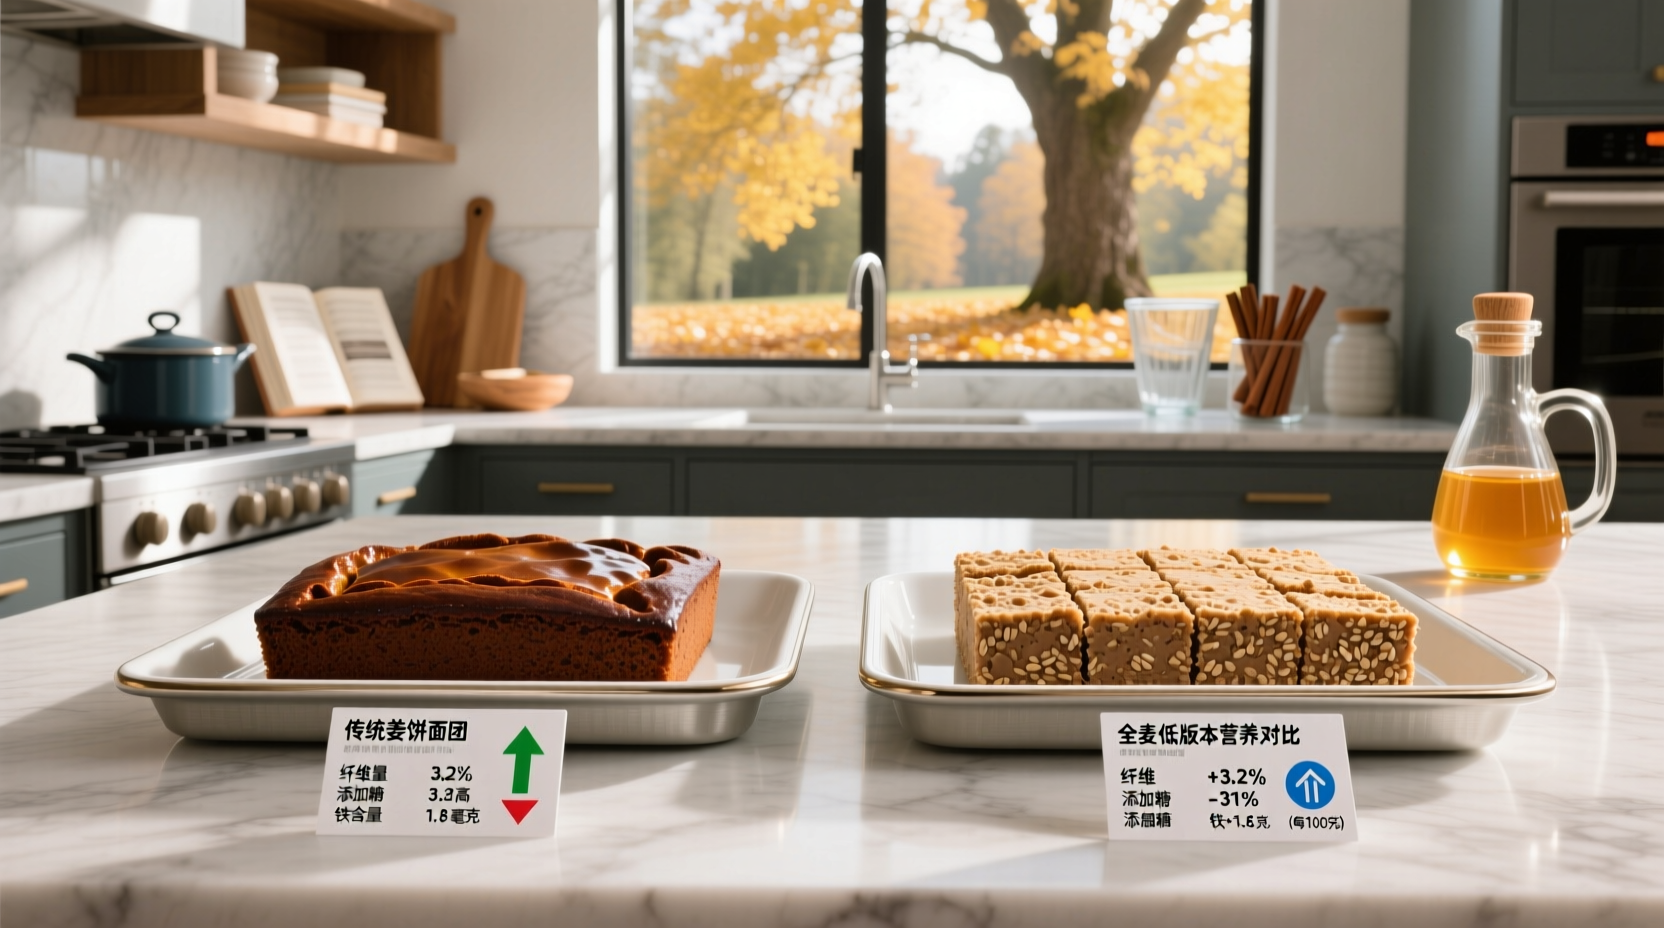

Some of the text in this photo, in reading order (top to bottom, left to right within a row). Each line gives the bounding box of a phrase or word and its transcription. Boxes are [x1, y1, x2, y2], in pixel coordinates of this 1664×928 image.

[344, 718, 468, 742] 传统姜饼面团
[1117, 723, 1301, 746] 全麦低版本营养对比
[430, 765, 473, 782] 3.2%
[1120, 767, 1267, 786] 纤维 +3.2%
[1122, 789, 1259, 808] 添加糖 -31%
